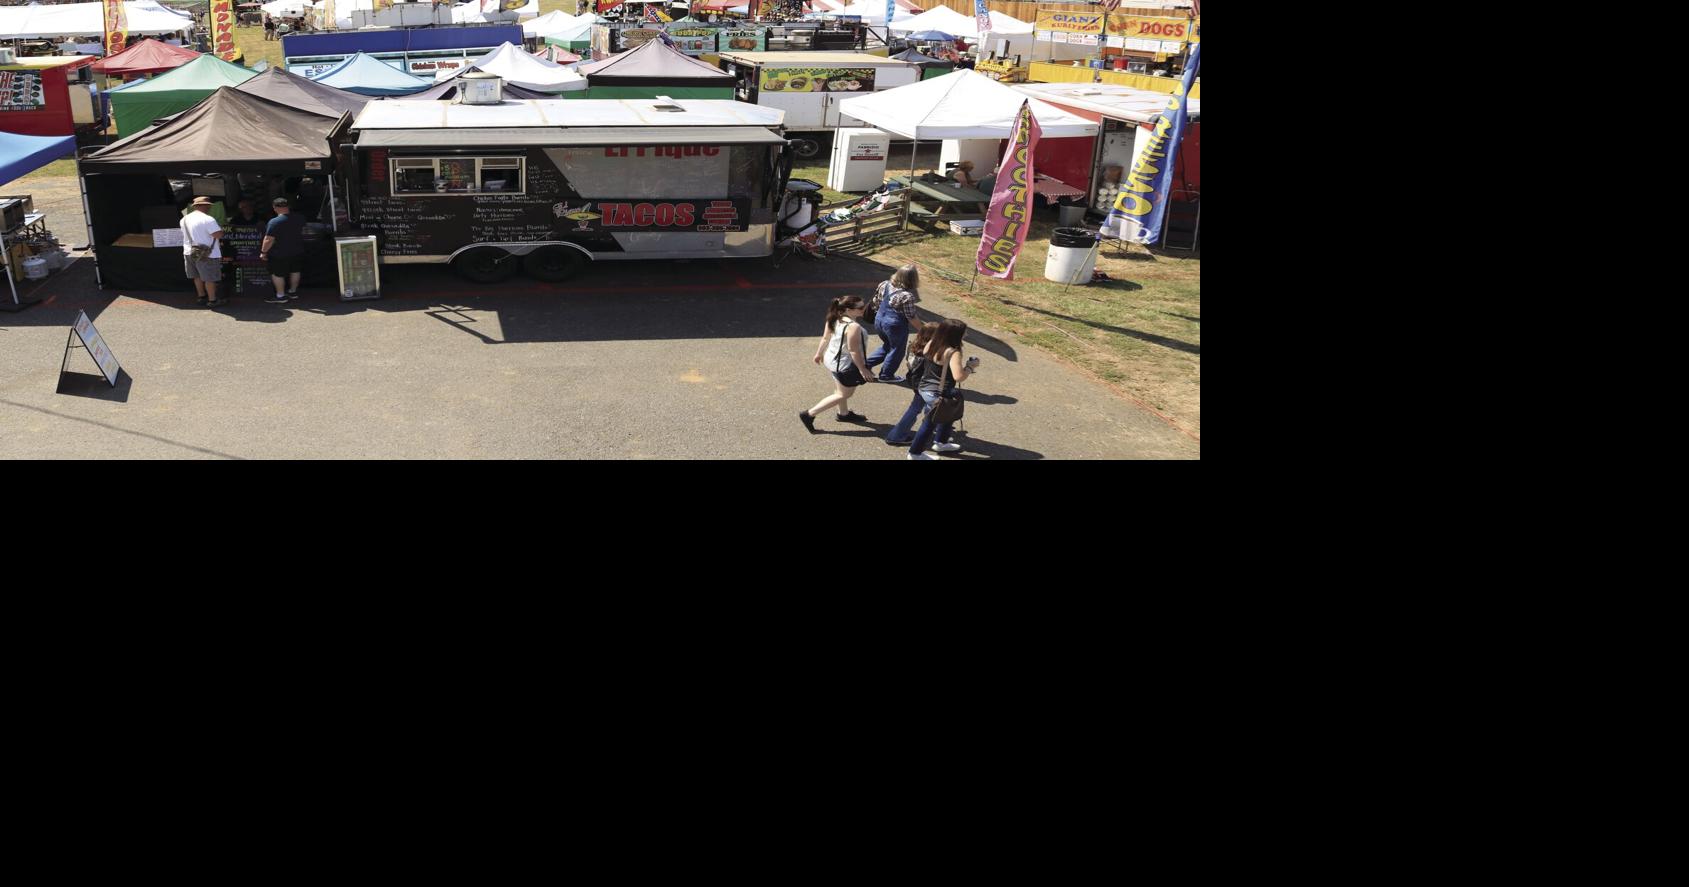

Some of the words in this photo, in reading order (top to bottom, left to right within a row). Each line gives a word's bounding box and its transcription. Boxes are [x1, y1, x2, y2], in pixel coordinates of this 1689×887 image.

[213, 0, 235, 60] MONADE
[1140, 22, 1185, 37] DOGS
[598, 202, 695, 227] TACOS
